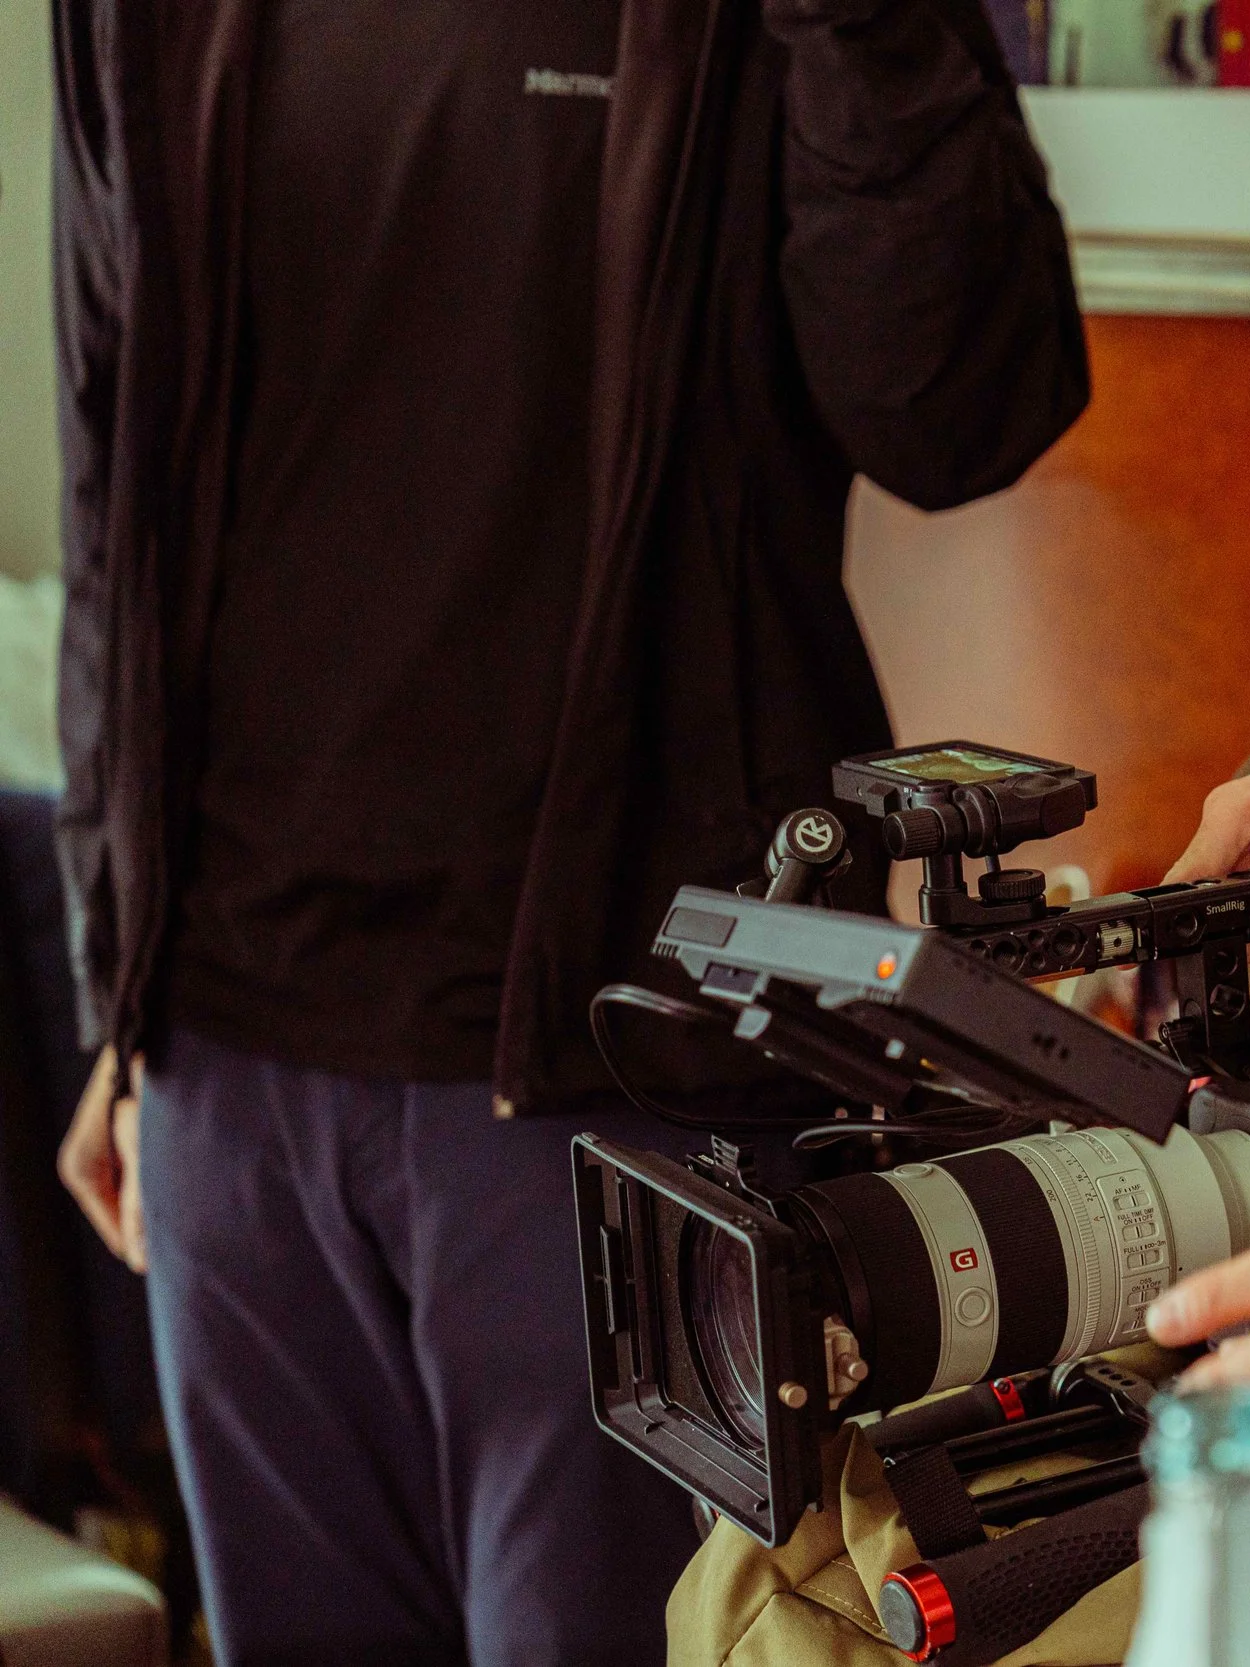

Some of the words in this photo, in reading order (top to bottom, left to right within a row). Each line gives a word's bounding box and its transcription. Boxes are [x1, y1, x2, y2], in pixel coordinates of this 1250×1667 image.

[1205, 900, 1246, 915] SmallRig
[1076, 1174, 1084, 1182] 16
[1114, 1187, 1124, 1195] AF
[1046, 1189, 1057, 1203] 200
[1085, 1193, 1094, 1202] 22
[1131, 1210, 1143, 1218] TIME
[1142, 1214, 1154, 1222] OFF
[1123, 1245, 1139, 1254] FULL
[955, 1251, 973, 1269] G
